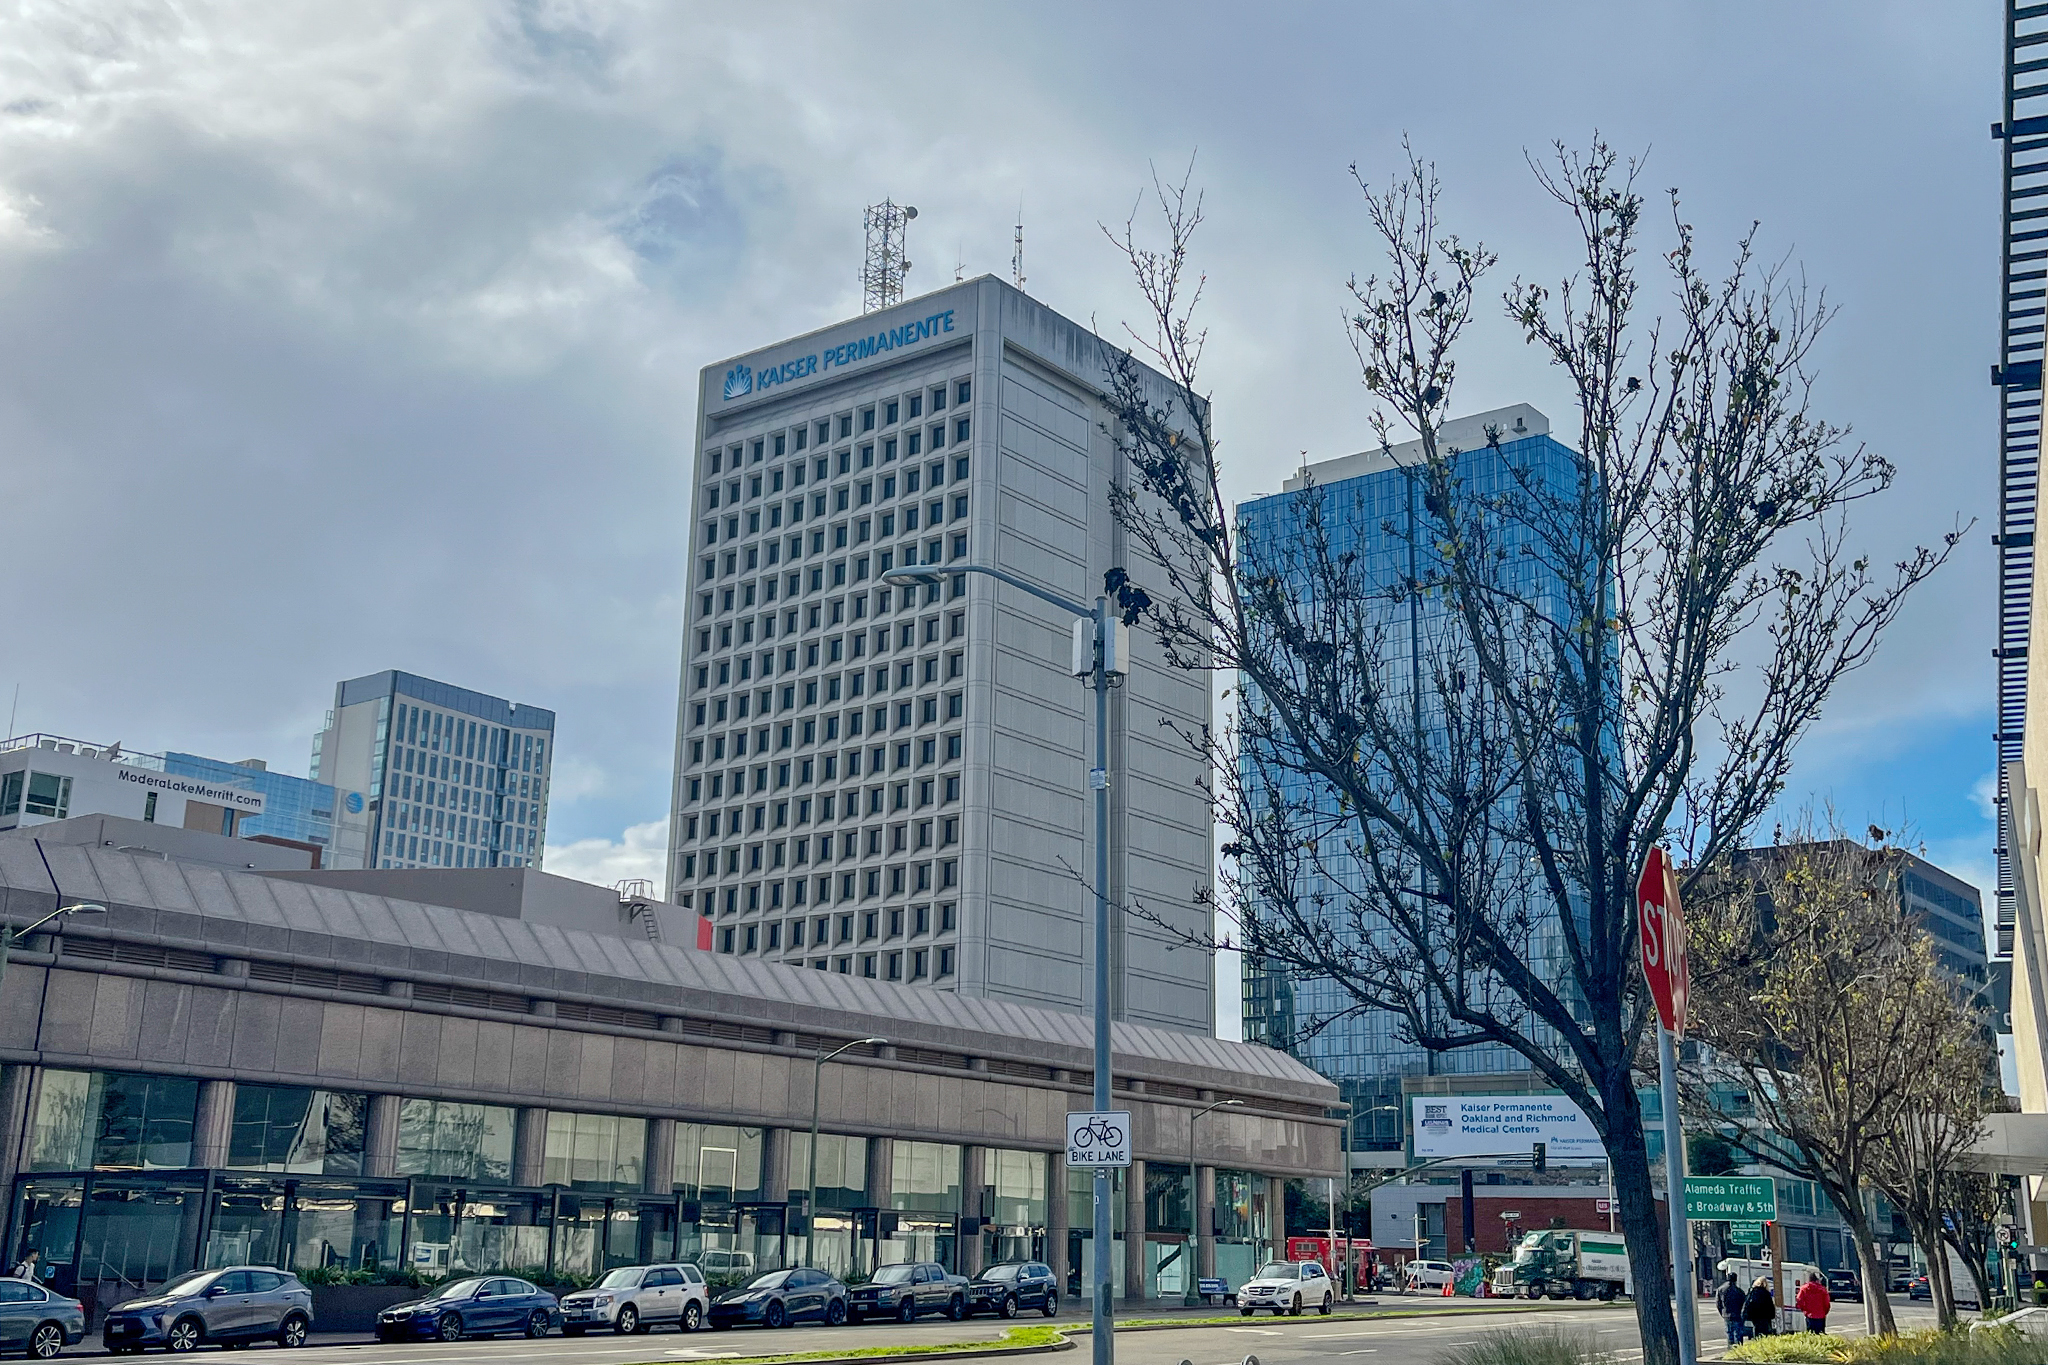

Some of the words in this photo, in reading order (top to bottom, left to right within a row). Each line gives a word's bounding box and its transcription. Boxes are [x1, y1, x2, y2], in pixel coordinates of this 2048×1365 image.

[756, 354, 817, 391] KAISER
[823, 309, 955, 371] PERMANENTE
[118, 770, 262, 808] ModeraLakeMerritt.com
[1643, 899, 1685, 981] STOP
[1425, 1105, 1447, 1114] BEST
[1461, 1103, 1490, 1112] Kaiser
[1494, 1102, 1553, 1112] Permanente
[1461, 1114, 1501, 1123] Oakland
[1504, 1114, 1523, 1123] and
[1526, 1113, 1576, 1123] Richmond
[1462, 1125, 1499, 1133] Medical
[1502, 1125, 1540, 1133] Centers
[1072, 1151, 1093, 1162] BIKE
[1098, 1151, 1124, 1162] LANE
[1685, 1183, 1725, 1195] Alameda
[1729, 1183, 1762, 1195] Traffic
[1696, 1201, 1744, 1215] Broadway
[1746, 1201, 1754, 1212] &
[1757, 1201, 1774, 1212] 5th
